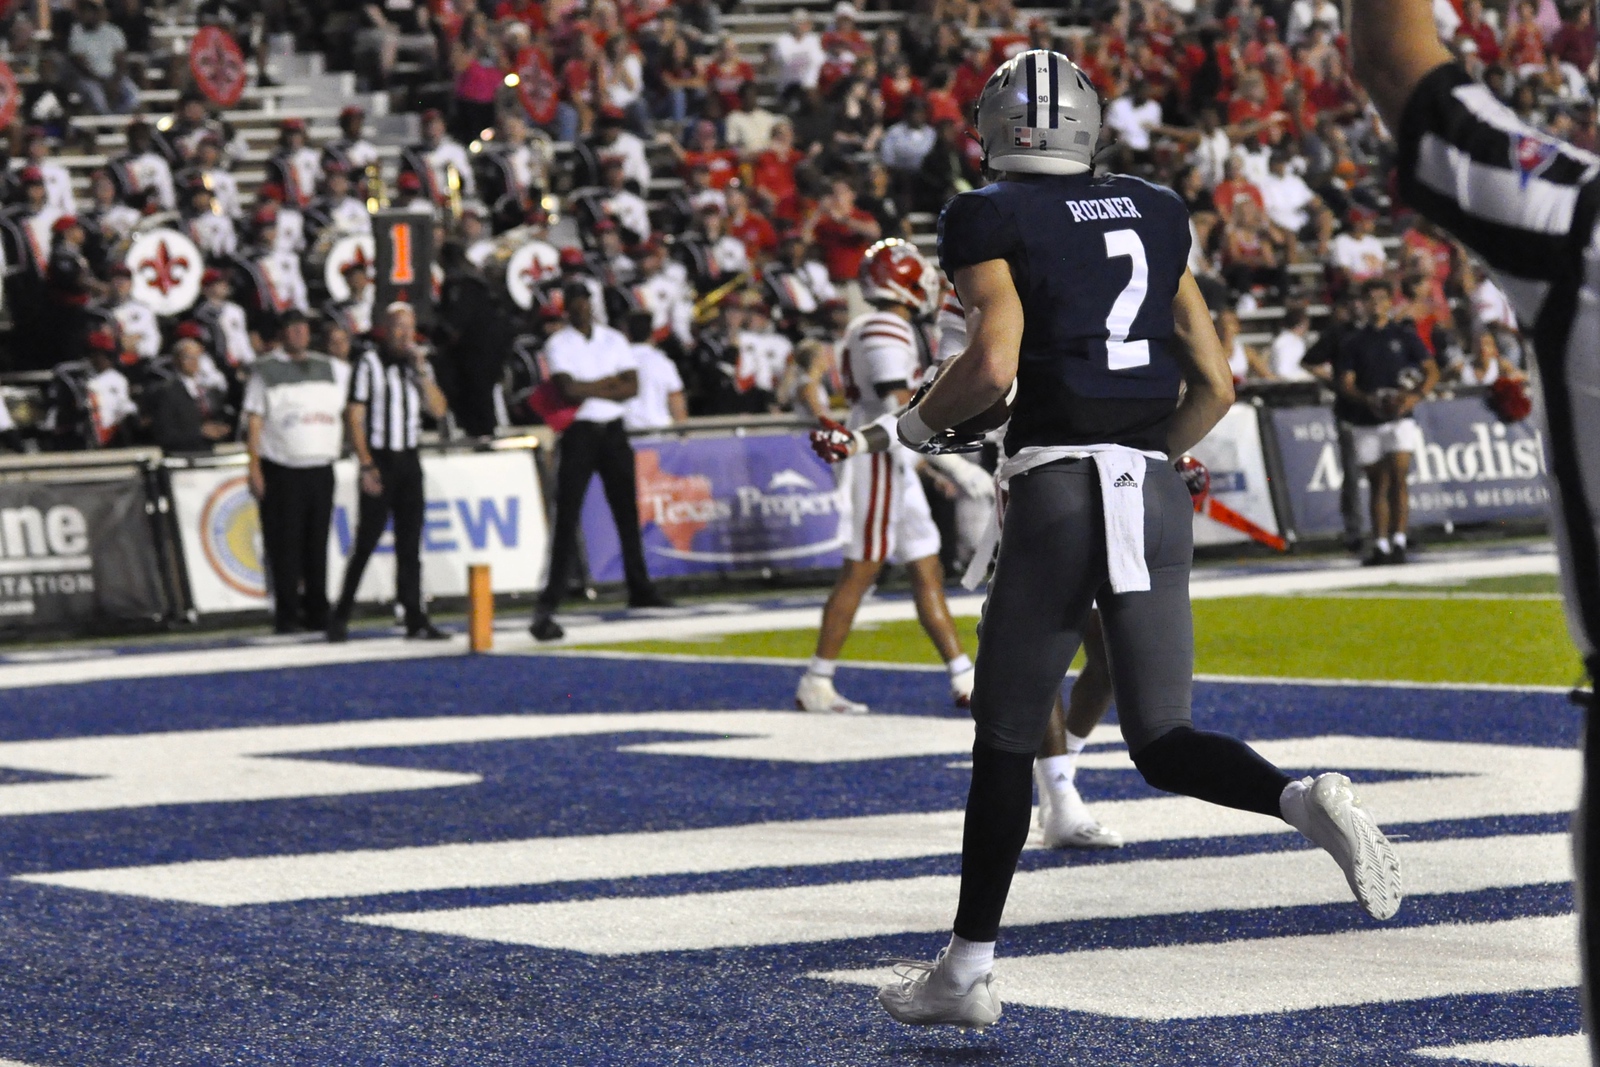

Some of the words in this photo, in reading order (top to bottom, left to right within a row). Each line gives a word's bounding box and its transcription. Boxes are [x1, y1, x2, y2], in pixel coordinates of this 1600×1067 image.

[1038, 95, 1048, 103] 90
[1039, 140, 1047, 151] 2
[1065, 196, 1142, 222] ROZNER
[390, 223, 415, 284] 1
[1103, 228, 1150, 371] 2
[1113, 480, 1138, 489] adidas
[643, 492, 731, 524] Texas
[0, 504, 89, 556] ne
[0, 574, 95, 596] TATION
